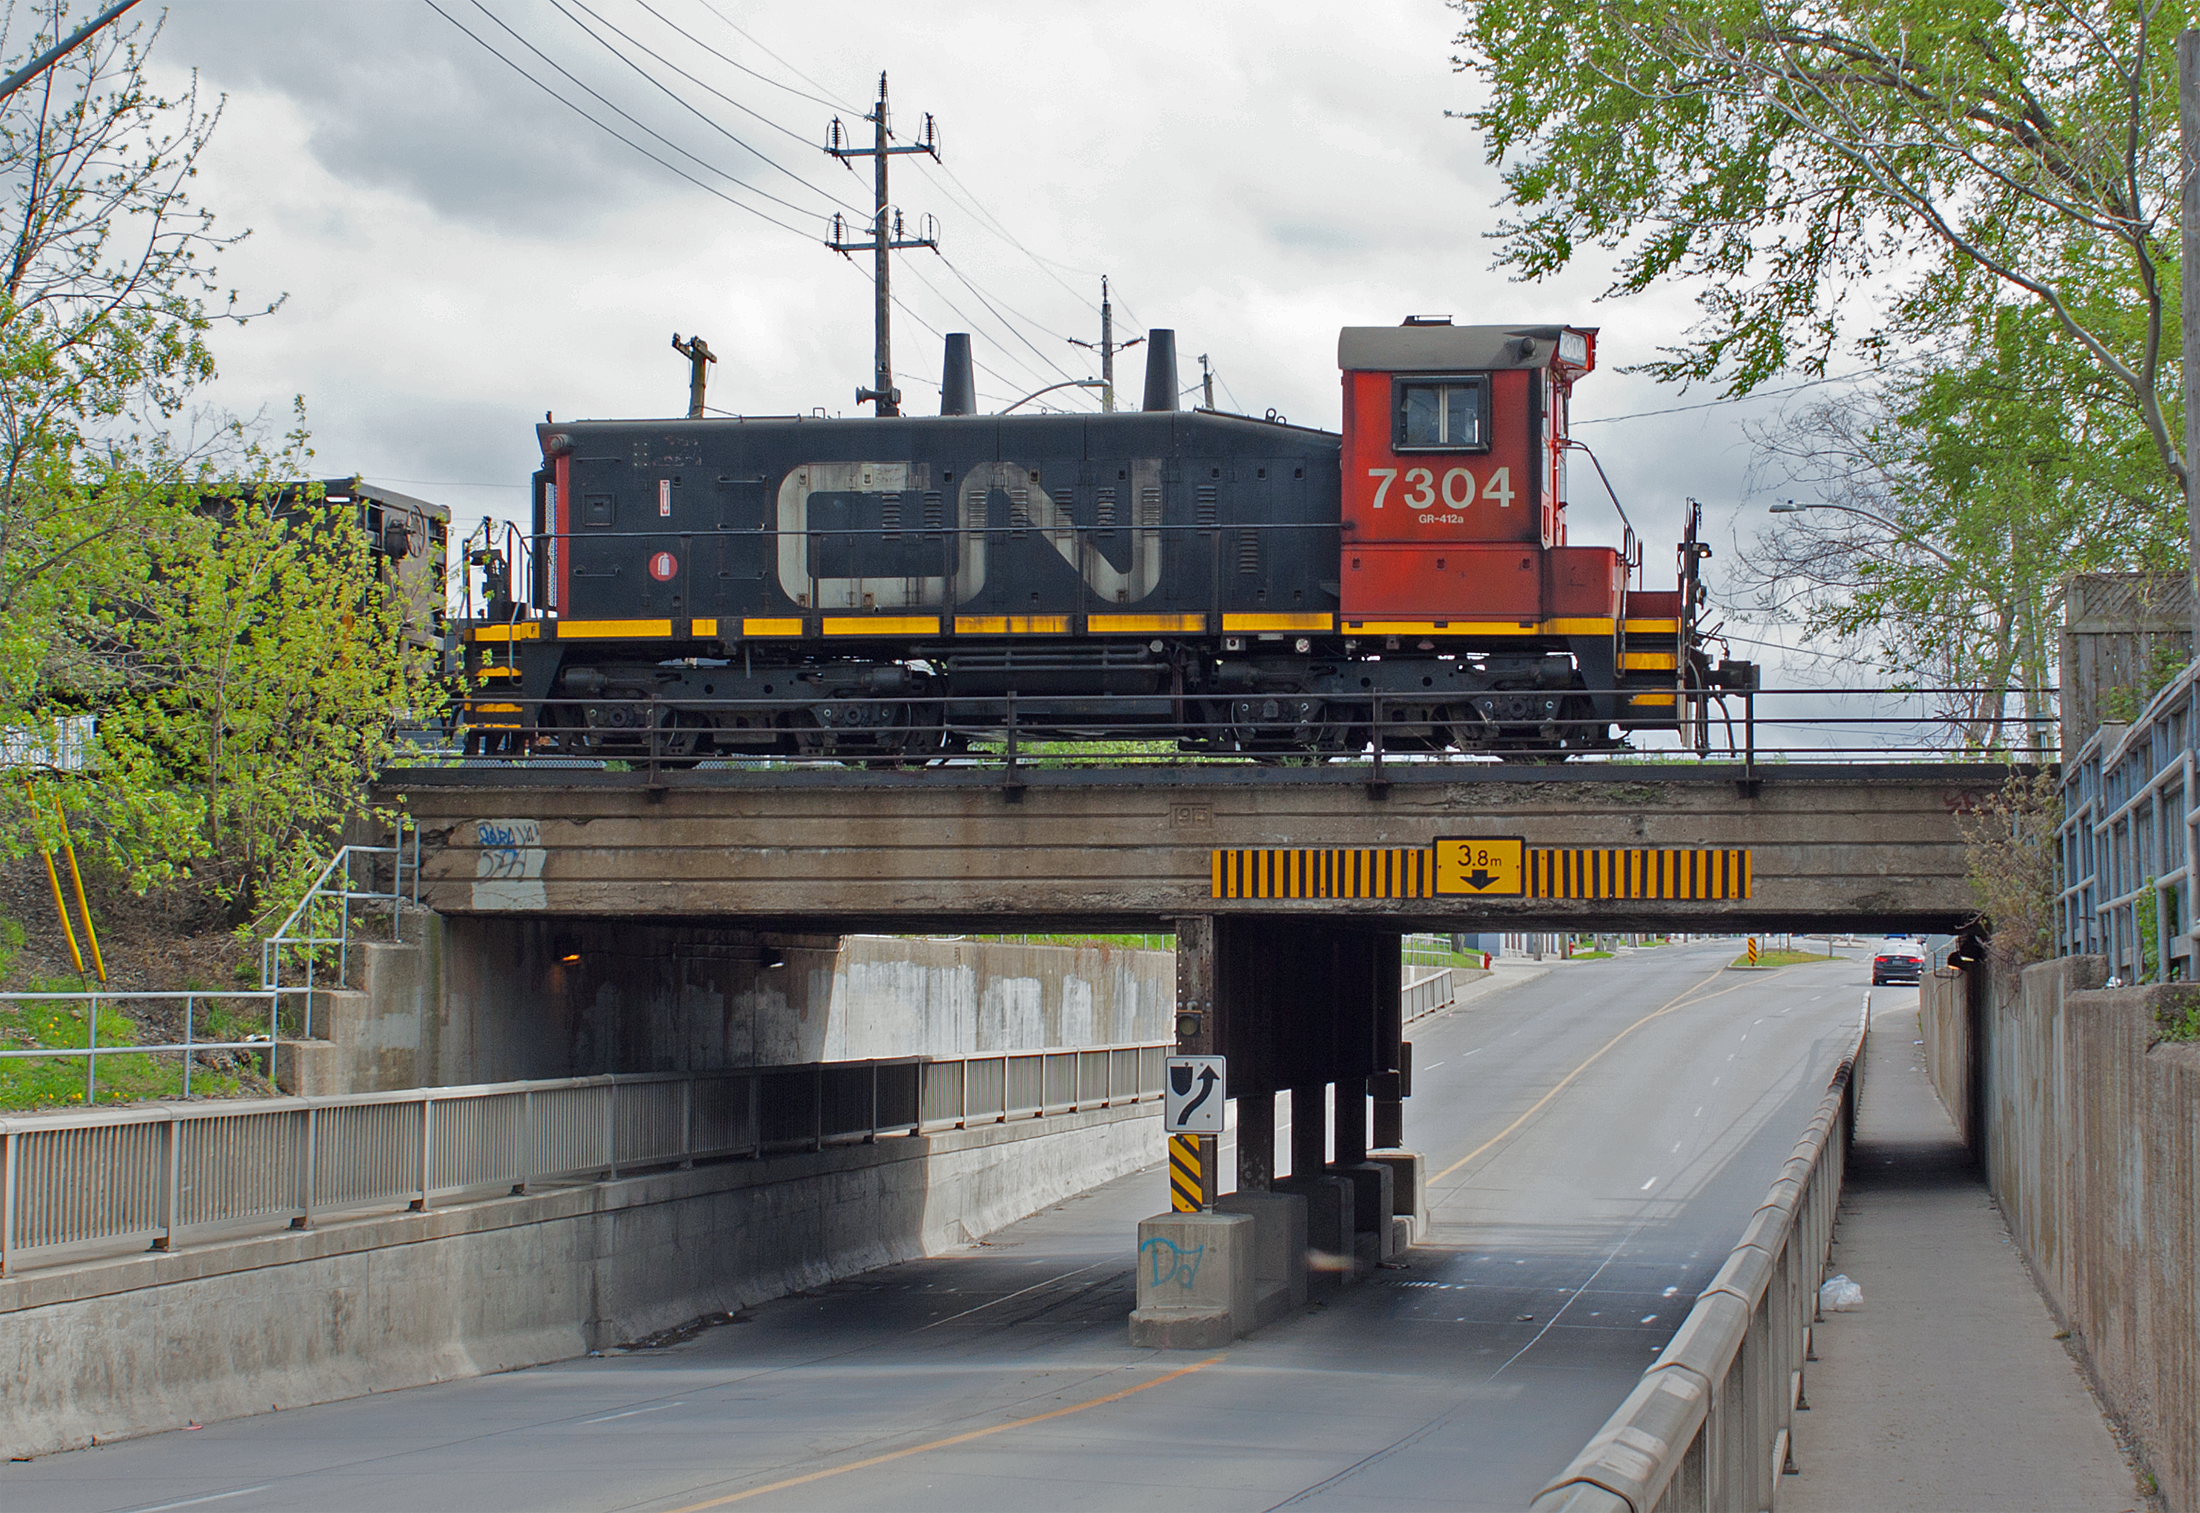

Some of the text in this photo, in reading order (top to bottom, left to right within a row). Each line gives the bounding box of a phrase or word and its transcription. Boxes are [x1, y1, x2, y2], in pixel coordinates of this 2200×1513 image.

[1368, 467, 1515, 509] 7304
[777, 459, 1162, 608] CN
[1418, 513, 1464, 524] GR-412a
